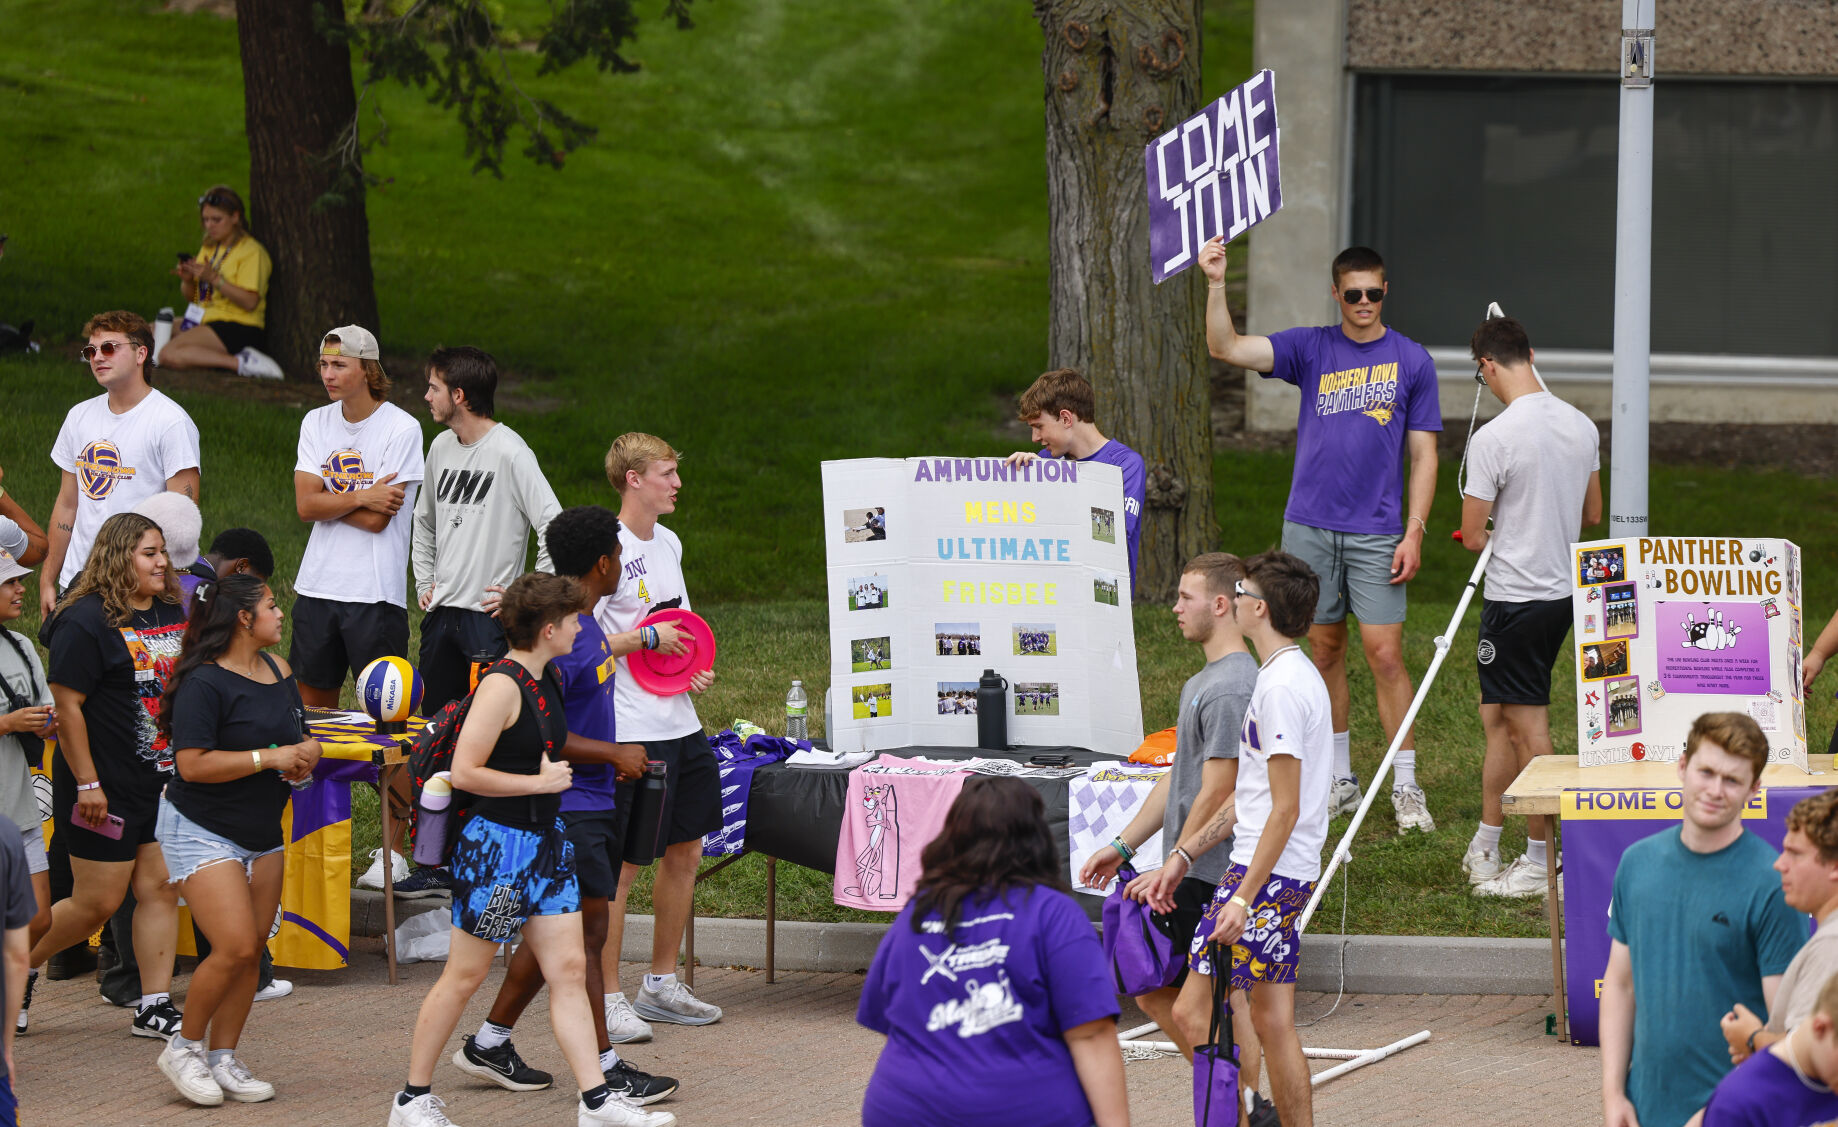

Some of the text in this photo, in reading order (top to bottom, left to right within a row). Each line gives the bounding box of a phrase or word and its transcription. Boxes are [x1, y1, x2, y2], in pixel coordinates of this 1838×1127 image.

[1156, 71, 1270, 202] COME
[1164, 151, 1271, 274] JOIN
[1370, 362, 1398, 384] IOWA
[1316, 380, 1397, 416] PANTHERS
[914, 459, 1077, 484] AMMUNITION
[436, 469, 496, 505] UNI
[965, 501, 1036, 524] MENS
[937, 537, 1071, 562] ULTIMATE
[1639, 538, 1744, 566] PANTHER
[638, 578, 651, 603] 4
[942, 580, 1058, 606] FRISBEE
[1664, 568, 1782, 596] BOWLING
[1576, 791, 1684, 811] HOME O
